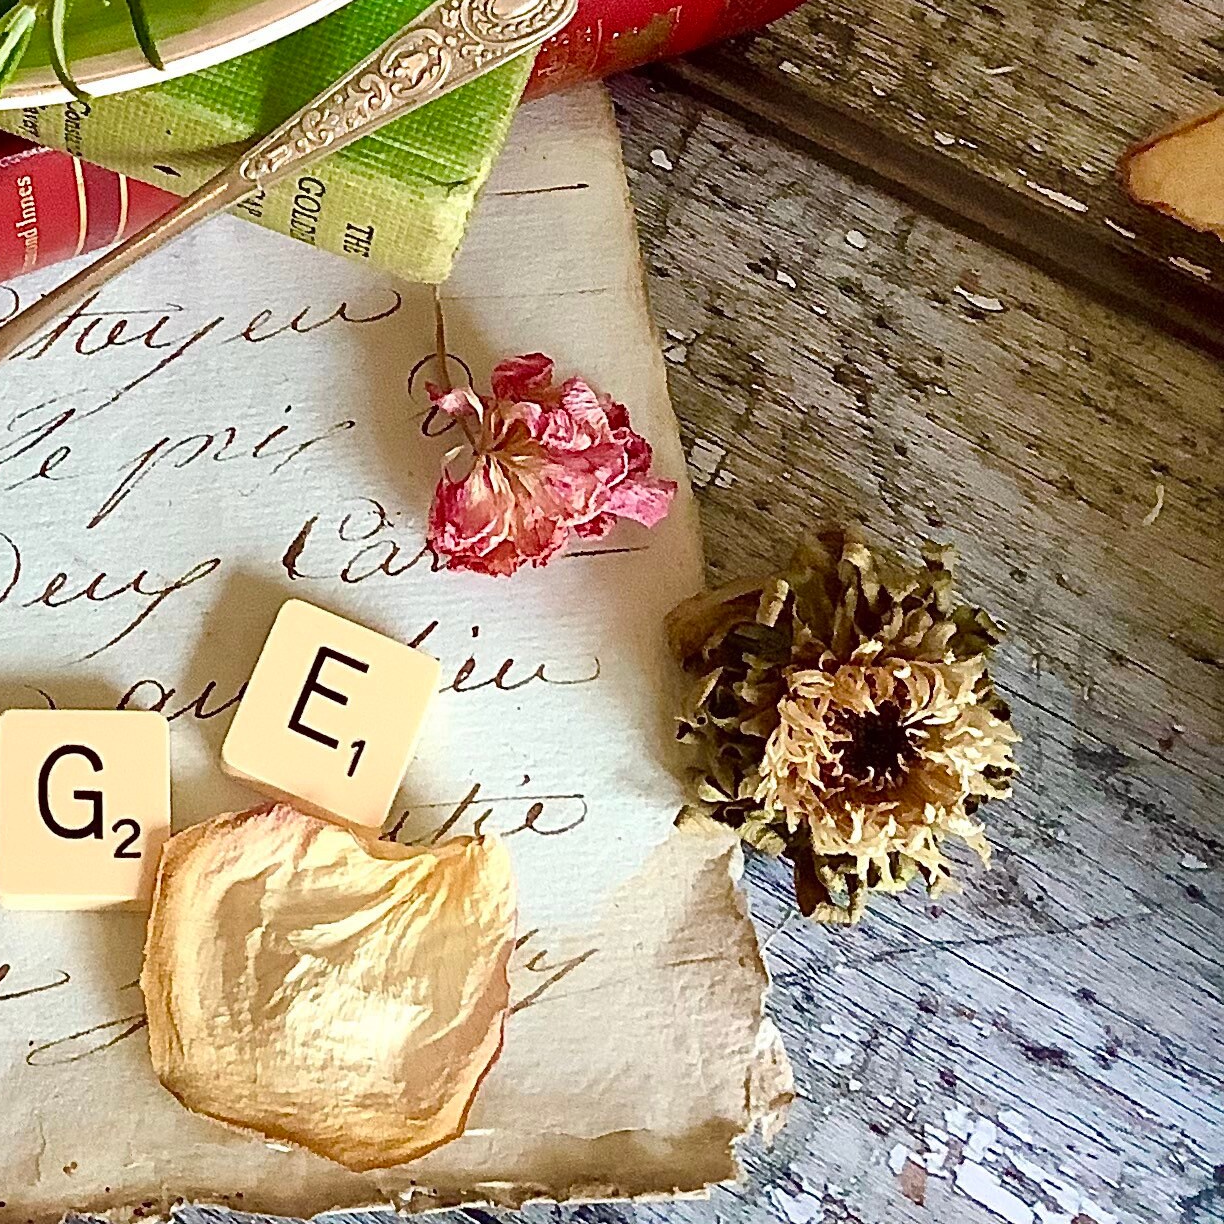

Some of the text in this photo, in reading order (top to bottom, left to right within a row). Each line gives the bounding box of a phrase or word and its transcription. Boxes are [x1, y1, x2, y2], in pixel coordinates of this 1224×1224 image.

[16, 175, 36, 227] Innes
[289, 177, 326, 246] GOLDE
[341, 223, 374, 257] THE
